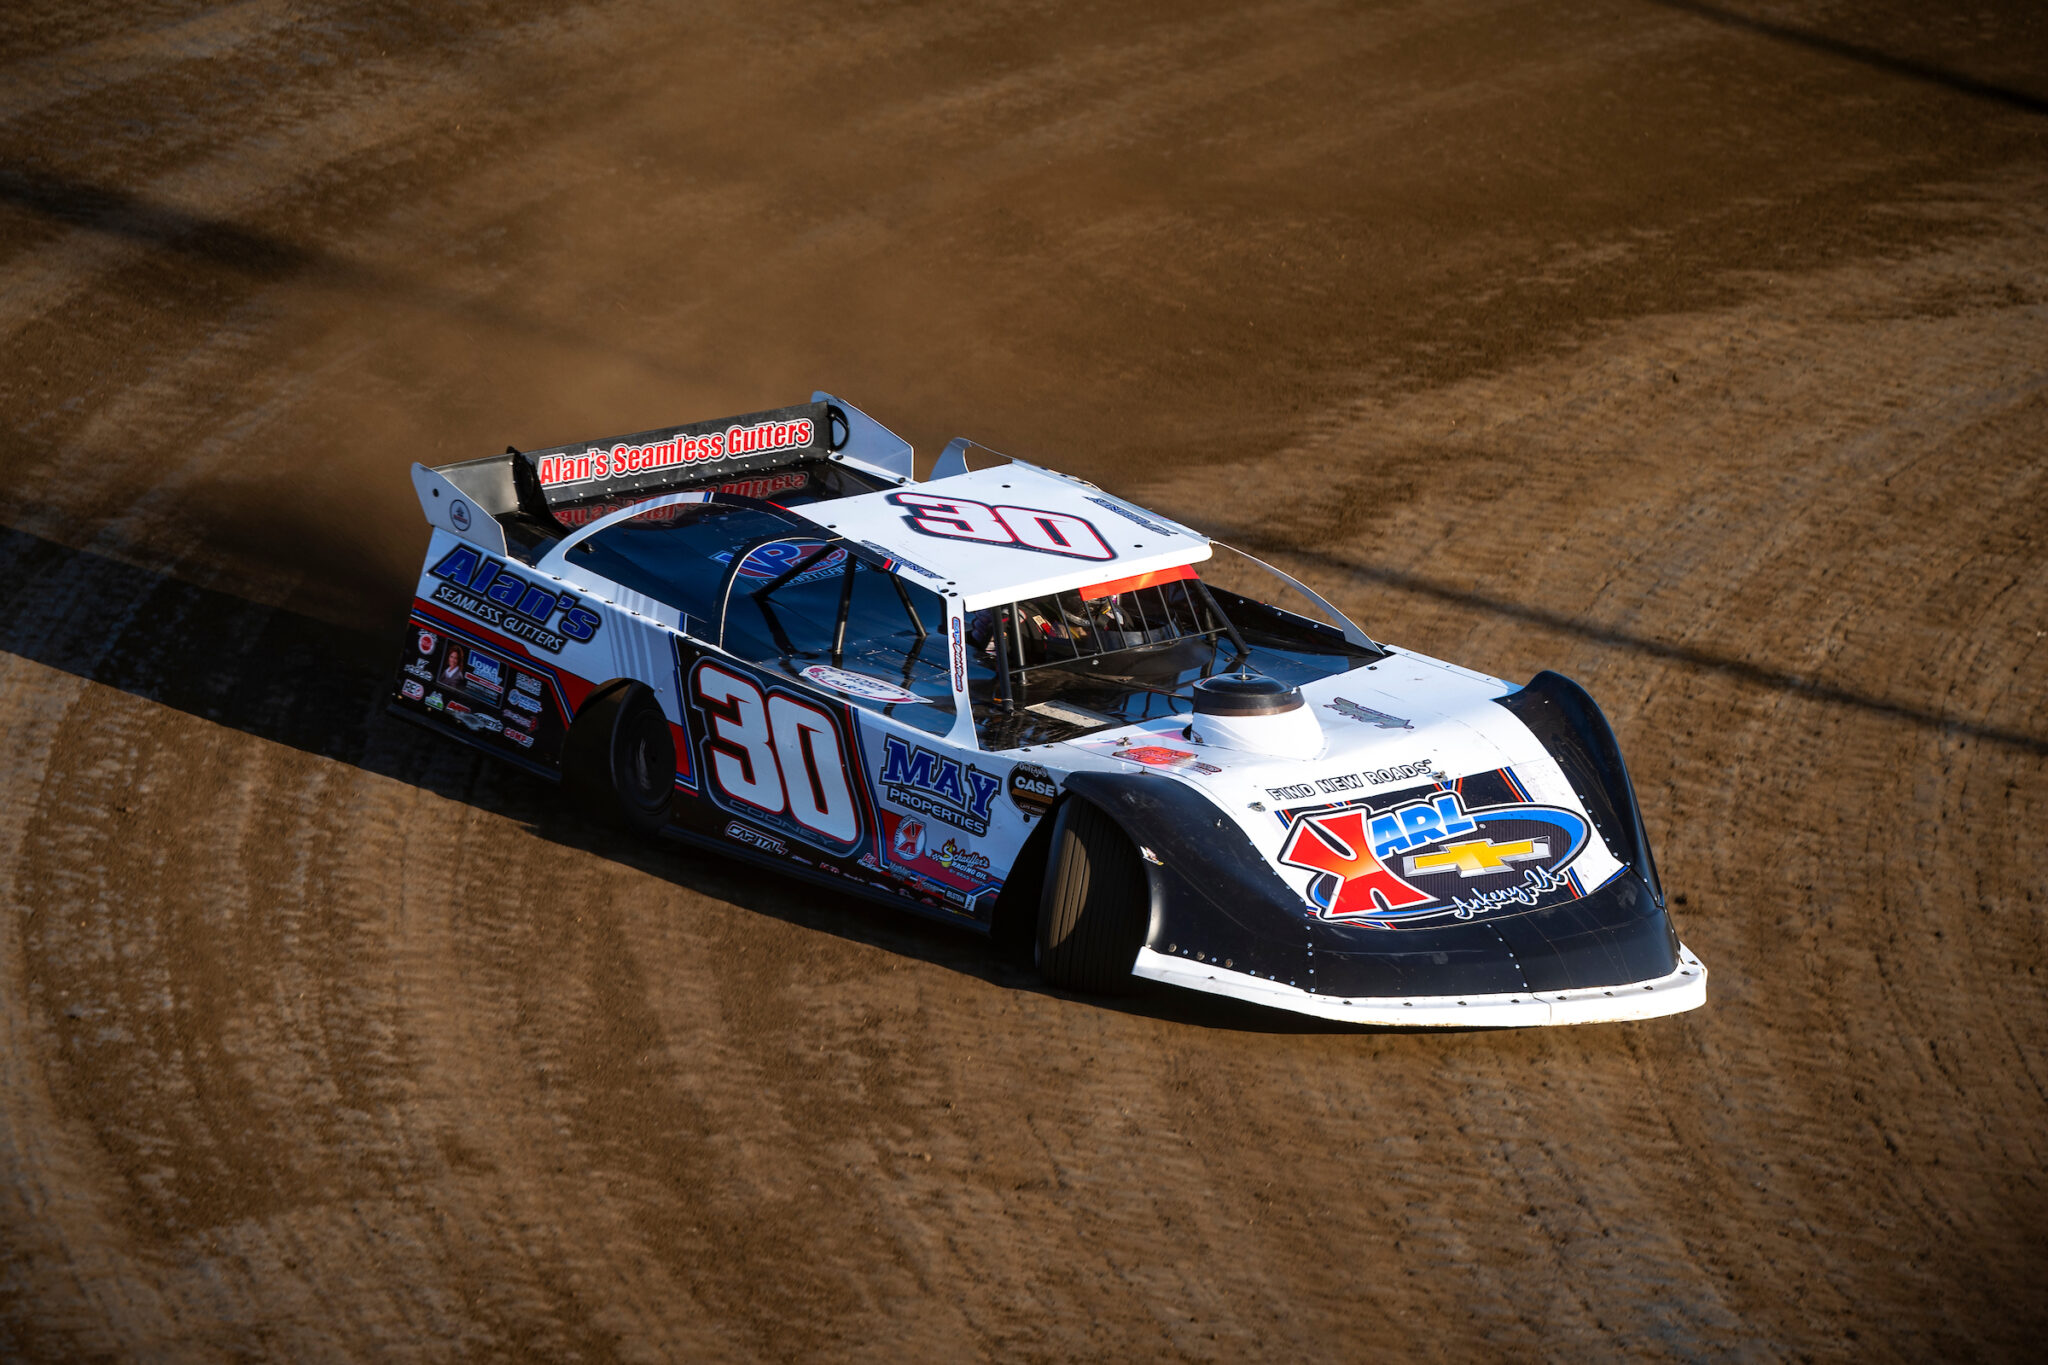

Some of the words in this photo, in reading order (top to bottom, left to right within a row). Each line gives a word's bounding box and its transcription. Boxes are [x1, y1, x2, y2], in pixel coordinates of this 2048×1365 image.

[540, 452, 608, 485] Alan's
[613, 437, 723, 472] Seamless
[727, 422, 812, 454] Gutters
[889, 490, 1116, 561] 30
[432, 546, 600, 641] Alan's
[436, 586, 503, 624] SEAMLESS
[503, 616, 563, 651] GUTTERS
[697, 664, 859, 844] 30
[882, 736, 999, 821] MAY
[888, 787, 985, 834] PROPERTIES
[1015, 776, 1056, 798] CASE
[1266, 784, 1316, 801] FIND
[1315, 774, 1364, 794] NEW
[730, 800, 834, 846] COONEY
